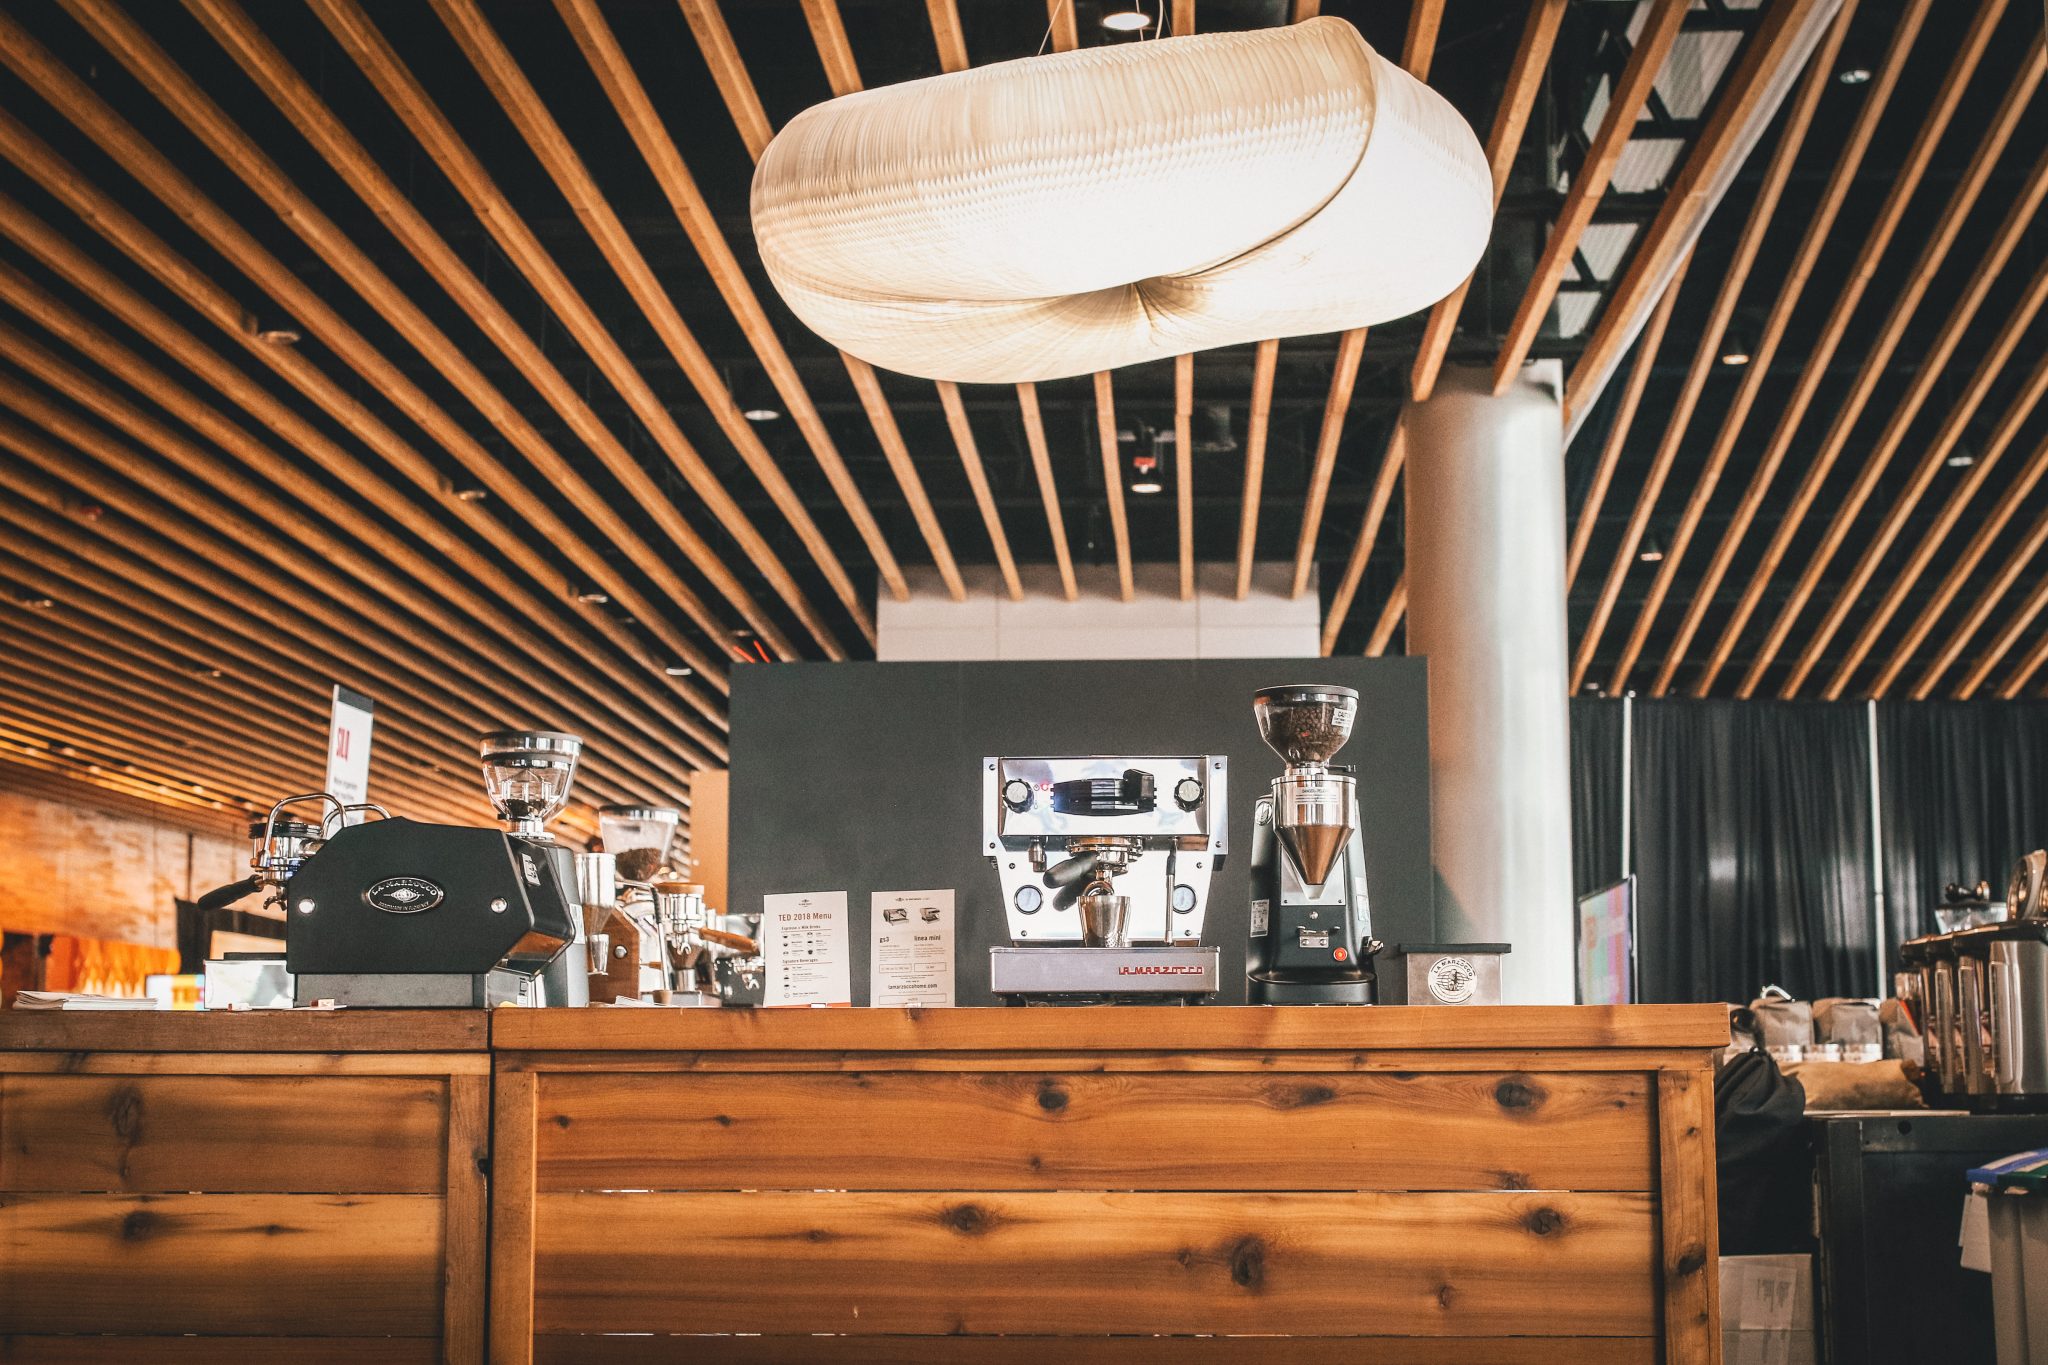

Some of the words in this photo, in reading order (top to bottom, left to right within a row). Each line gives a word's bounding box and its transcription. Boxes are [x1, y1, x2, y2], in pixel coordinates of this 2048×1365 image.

[372, 886, 384, 895] LA
[778, 914, 791, 922] TED
[794, 913, 811, 921] 2018
[813, 912, 832, 920] Menu
[1134, 966, 1204, 975] MARZOCCO
[1434, 966, 1441, 974] LA
[1441, 960, 1473, 977] MARZOCCO
